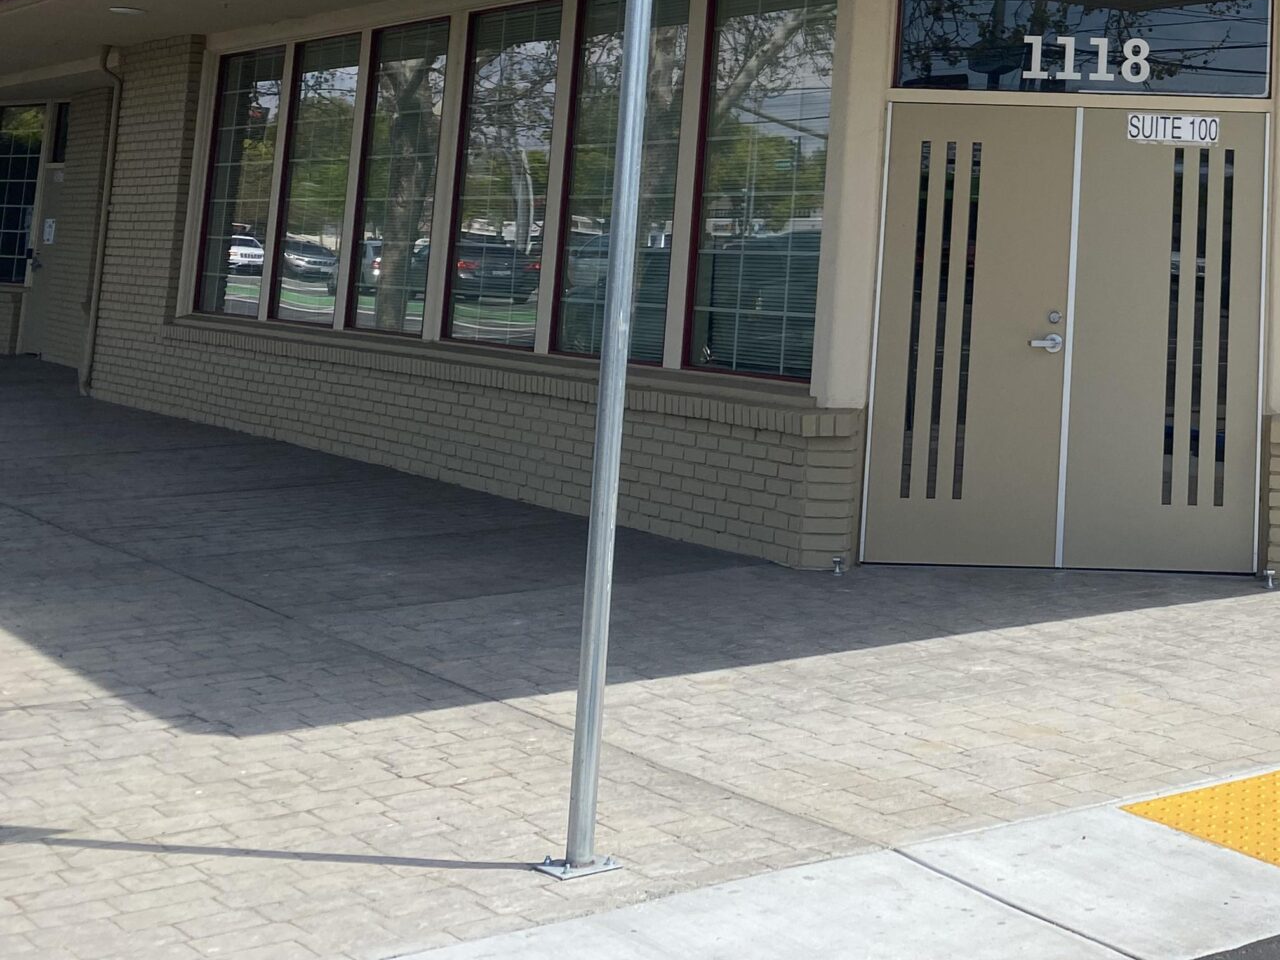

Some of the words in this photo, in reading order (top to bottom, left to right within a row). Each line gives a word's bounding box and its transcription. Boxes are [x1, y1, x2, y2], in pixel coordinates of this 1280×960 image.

[1022, 35, 1150, 83] 1118
[1128, 115, 1182, 140] SUITE
[1189, 118, 1218, 141] 100
